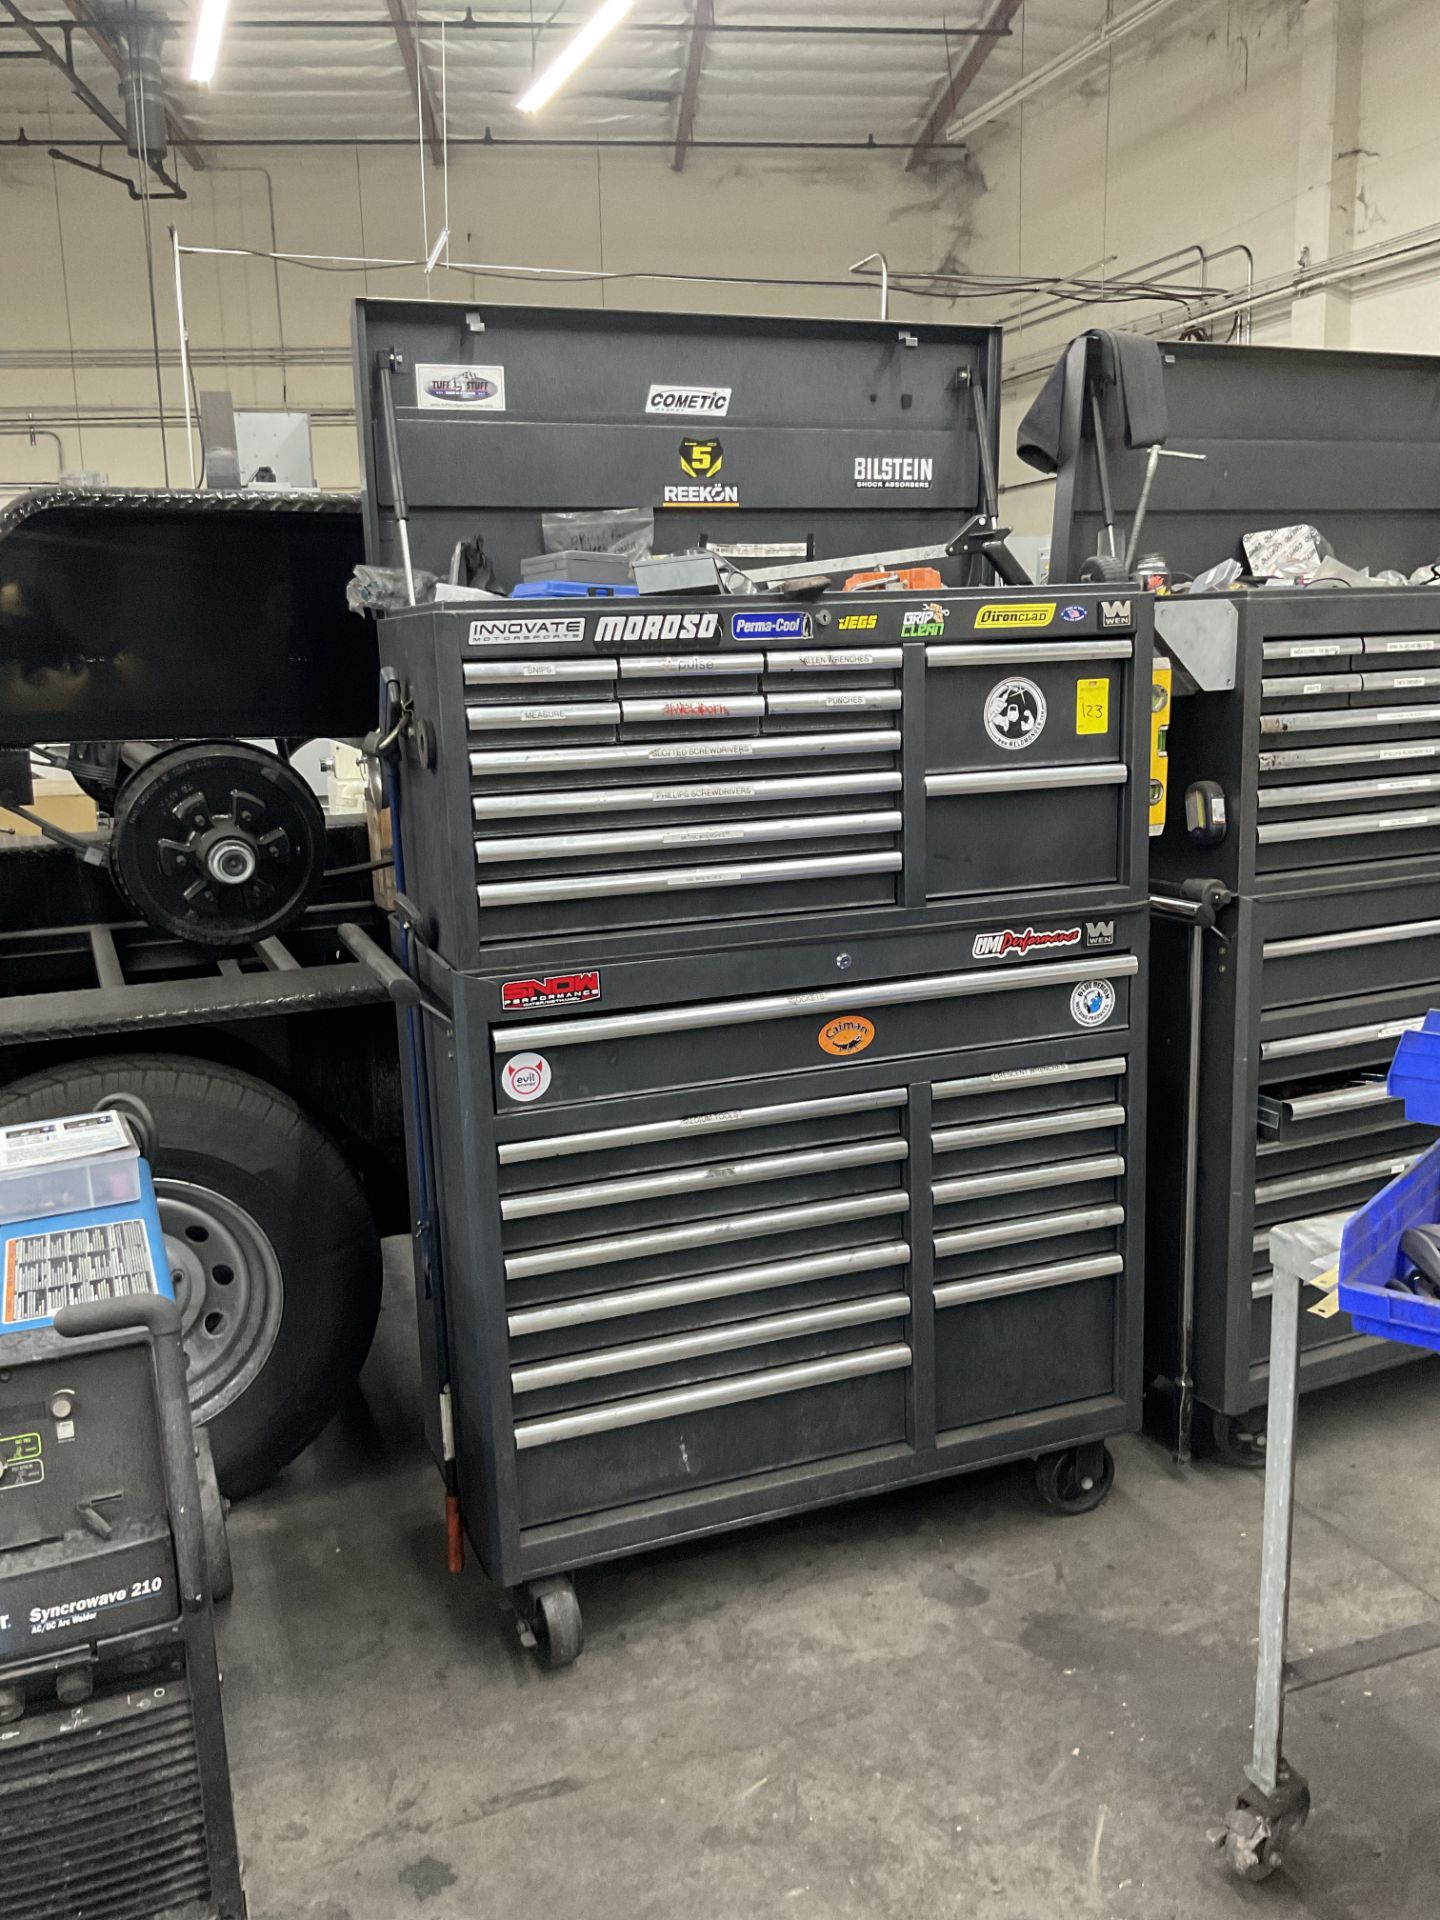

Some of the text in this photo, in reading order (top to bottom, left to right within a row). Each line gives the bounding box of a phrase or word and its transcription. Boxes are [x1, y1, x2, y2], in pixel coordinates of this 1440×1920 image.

[432, 380, 488, 390] TUFF STUFF
[692, 446, 712, 469] 5
[854, 457, 933, 480] BILSTEIN
[838, 615, 878, 629] JEGS
[904, 611, 933, 625] GRIP
[1106, 617, 1129, 625] WEN
[474, 621, 581, 635] INNOVATE
[594, 613, 719, 641] MOROSO
[736, 618, 800, 633] Perma-Cool
[472, 634, 580, 642] MOTORSPORTS
[678, 657, 714, 672] pulse
[828, 655, 870, 665] WRENCHES
[527, 664, 553, 674] SNIPS
[827, 696, 864, 705] PUNCHES
[524, 710, 565, 719] MEASURE
[1081, 704, 1103, 719] 123
[688, 744, 750, 756] SCREWDRIVERS
[655, 787, 752, 800] PHILLIPS SCREWDRIVERS
[975, 929, 1079, 954] UMI Performance
[1089, 936, 1111, 944] WEN
[504, 972, 599, 1000] SNOW
[1077, 981, 1110, 1000] BLUE DEMON
[504, 989, 599, 1005] PERFORMANCE
[826, 1021, 868, 1039] Caiman
[517, 1073, 535, 1084] evil
[29, 1588, 127, 1623] Syncrowave
[131, 1576, 162, 1598] 210
[31, 1611, 97, 1634] AC/DC Arc Welder
